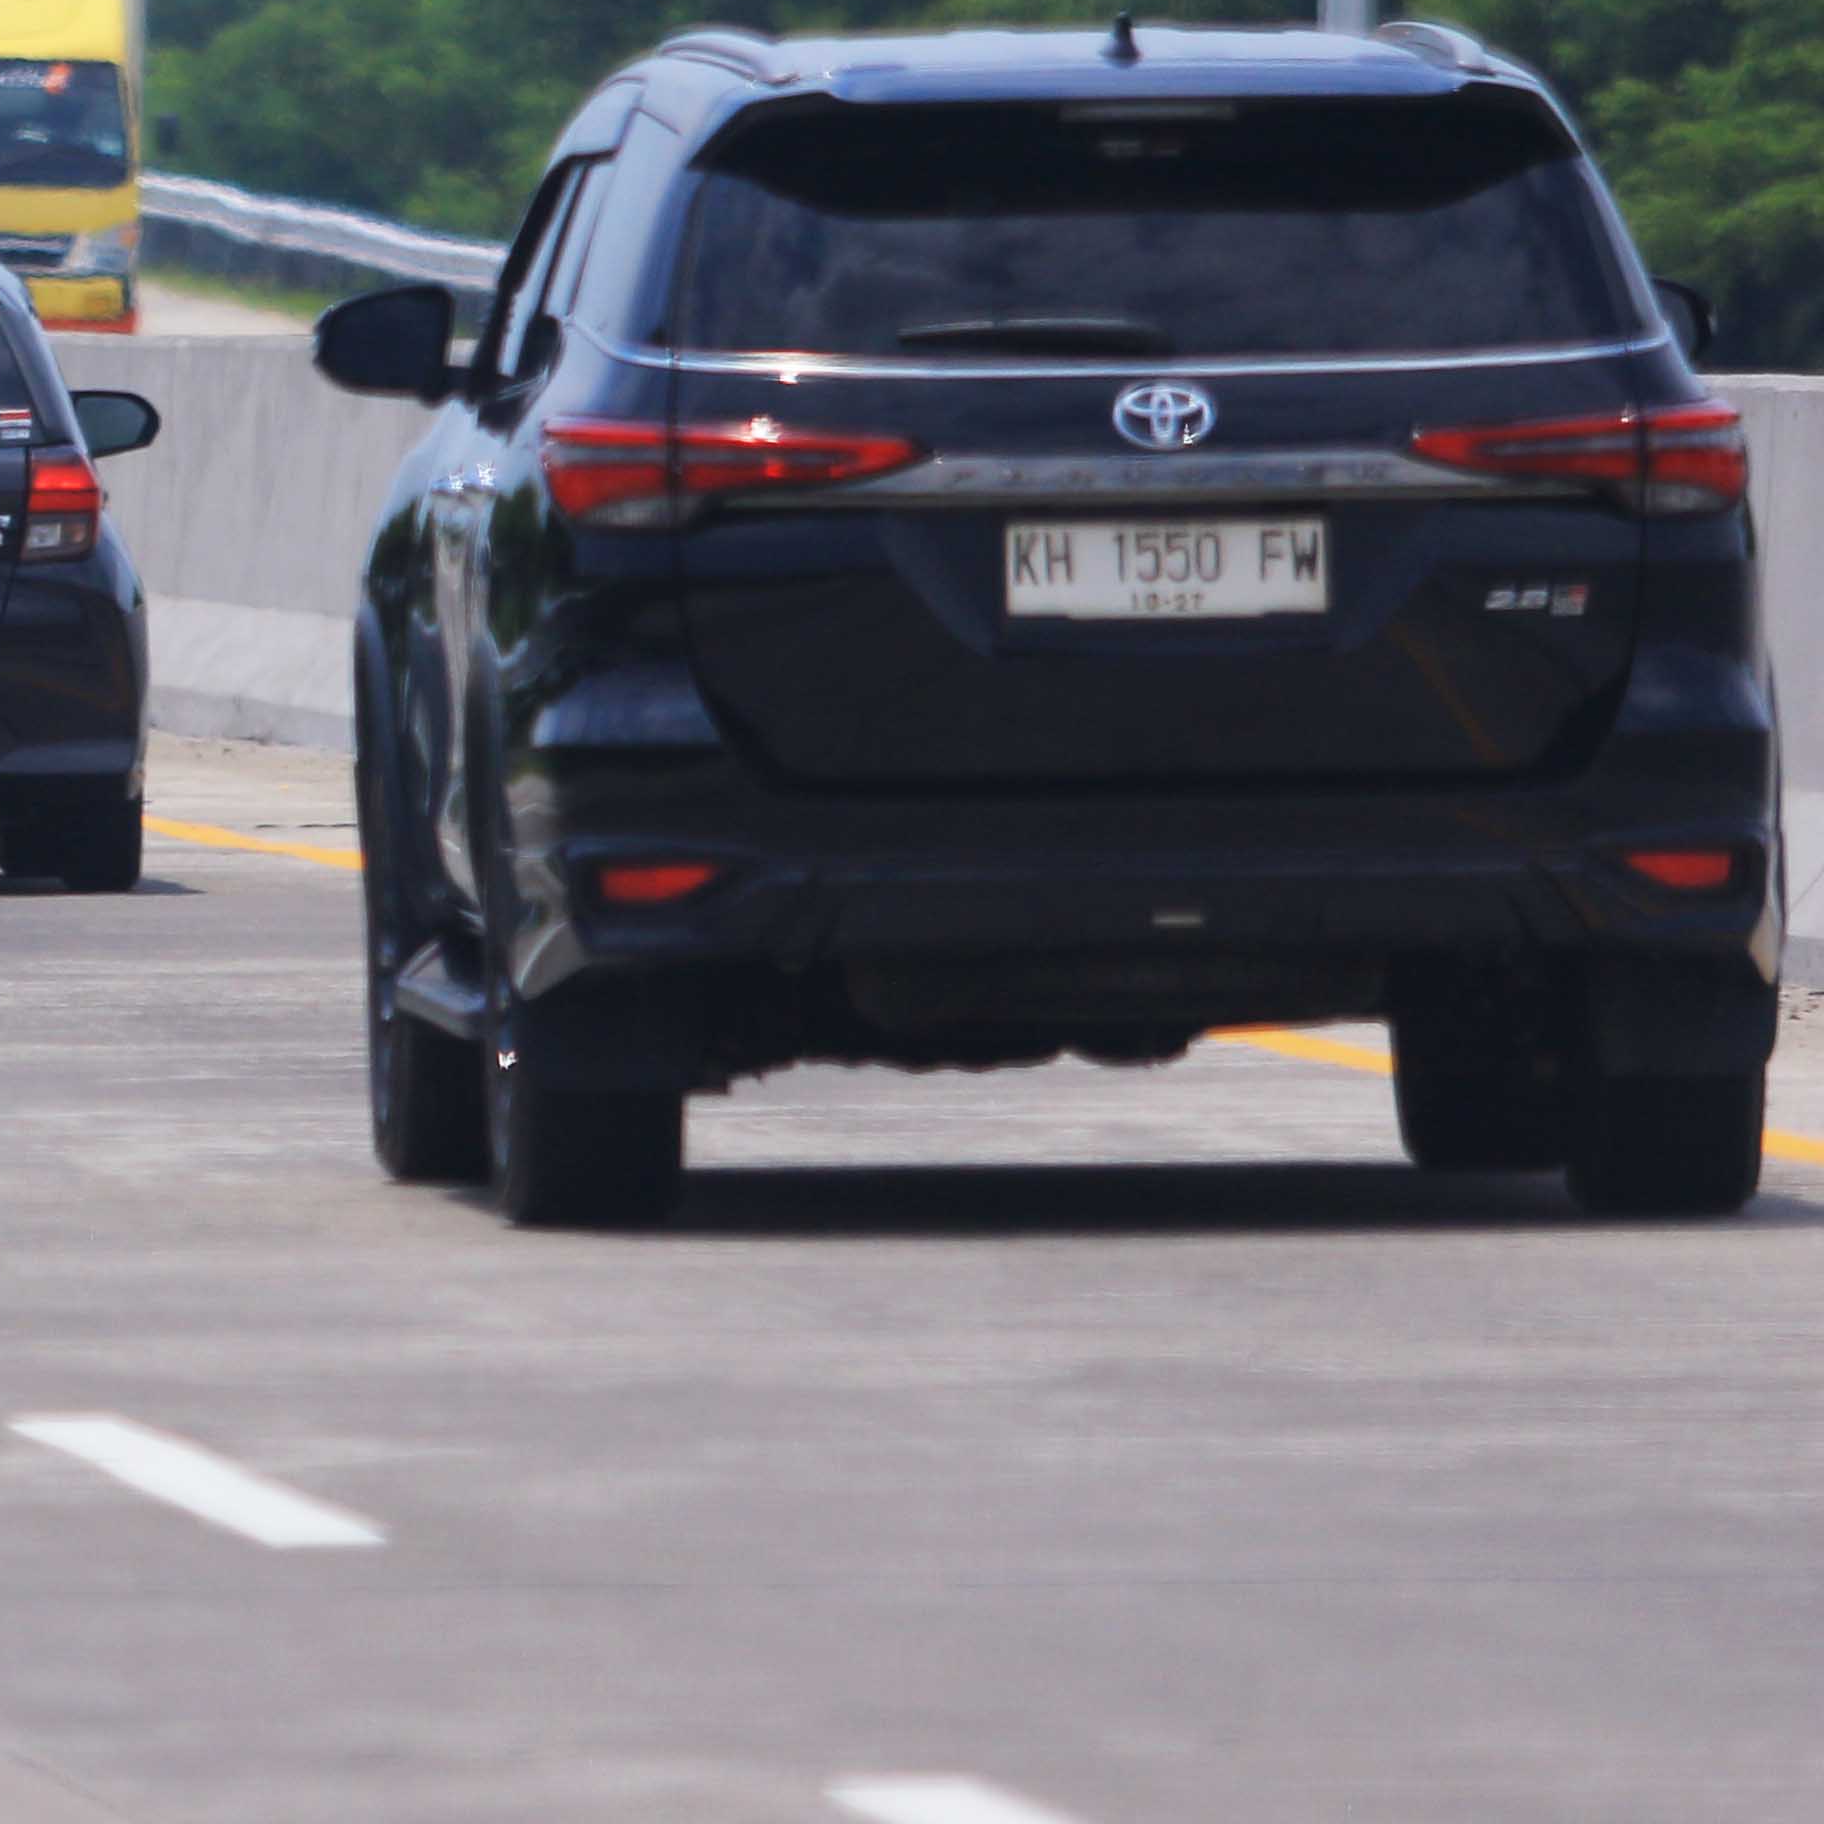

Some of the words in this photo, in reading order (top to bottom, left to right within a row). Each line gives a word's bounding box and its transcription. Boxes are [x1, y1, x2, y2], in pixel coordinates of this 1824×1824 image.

[1013, 531, 1075, 586] KH
[1113, 531, 1223, 584] 1550
[1259, 529, 1319, 583] FW
